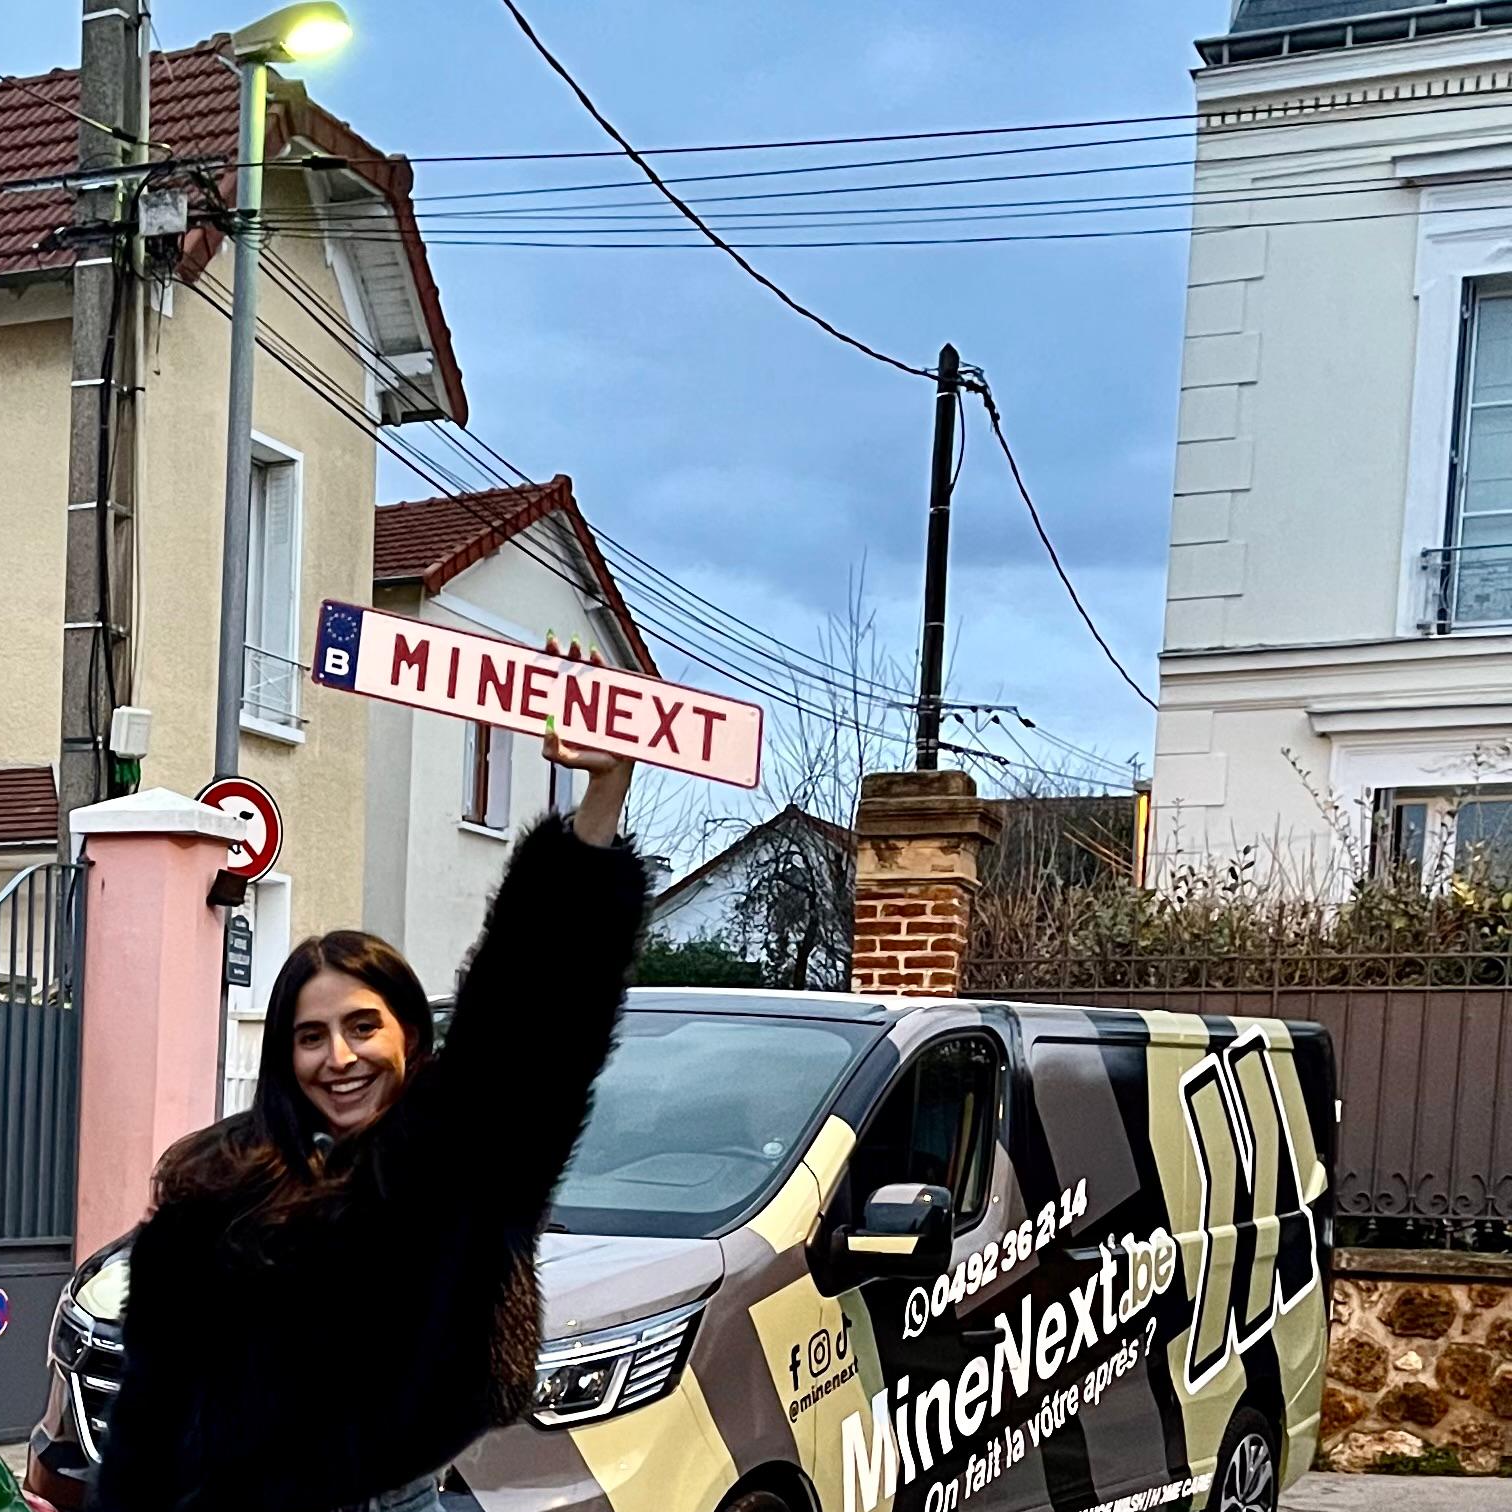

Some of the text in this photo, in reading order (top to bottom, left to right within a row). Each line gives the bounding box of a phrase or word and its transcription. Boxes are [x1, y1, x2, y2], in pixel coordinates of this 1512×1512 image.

[324, 634, 727, 762] B MINENEXT
[931, 1241, 999, 1317] 0492
[1001, 1219, 1032, 1272] 36
[1059, 1178, 1088, 1230] 14
[789, 1355, 859, 1423] @minenext
[965, 1436, 1002, 1499] fait
[1005, 1426, 1025, 1468] la
[1028, 1385, 1079, 1447] vôtre
[1084, 1338, 1139, 1405] après
